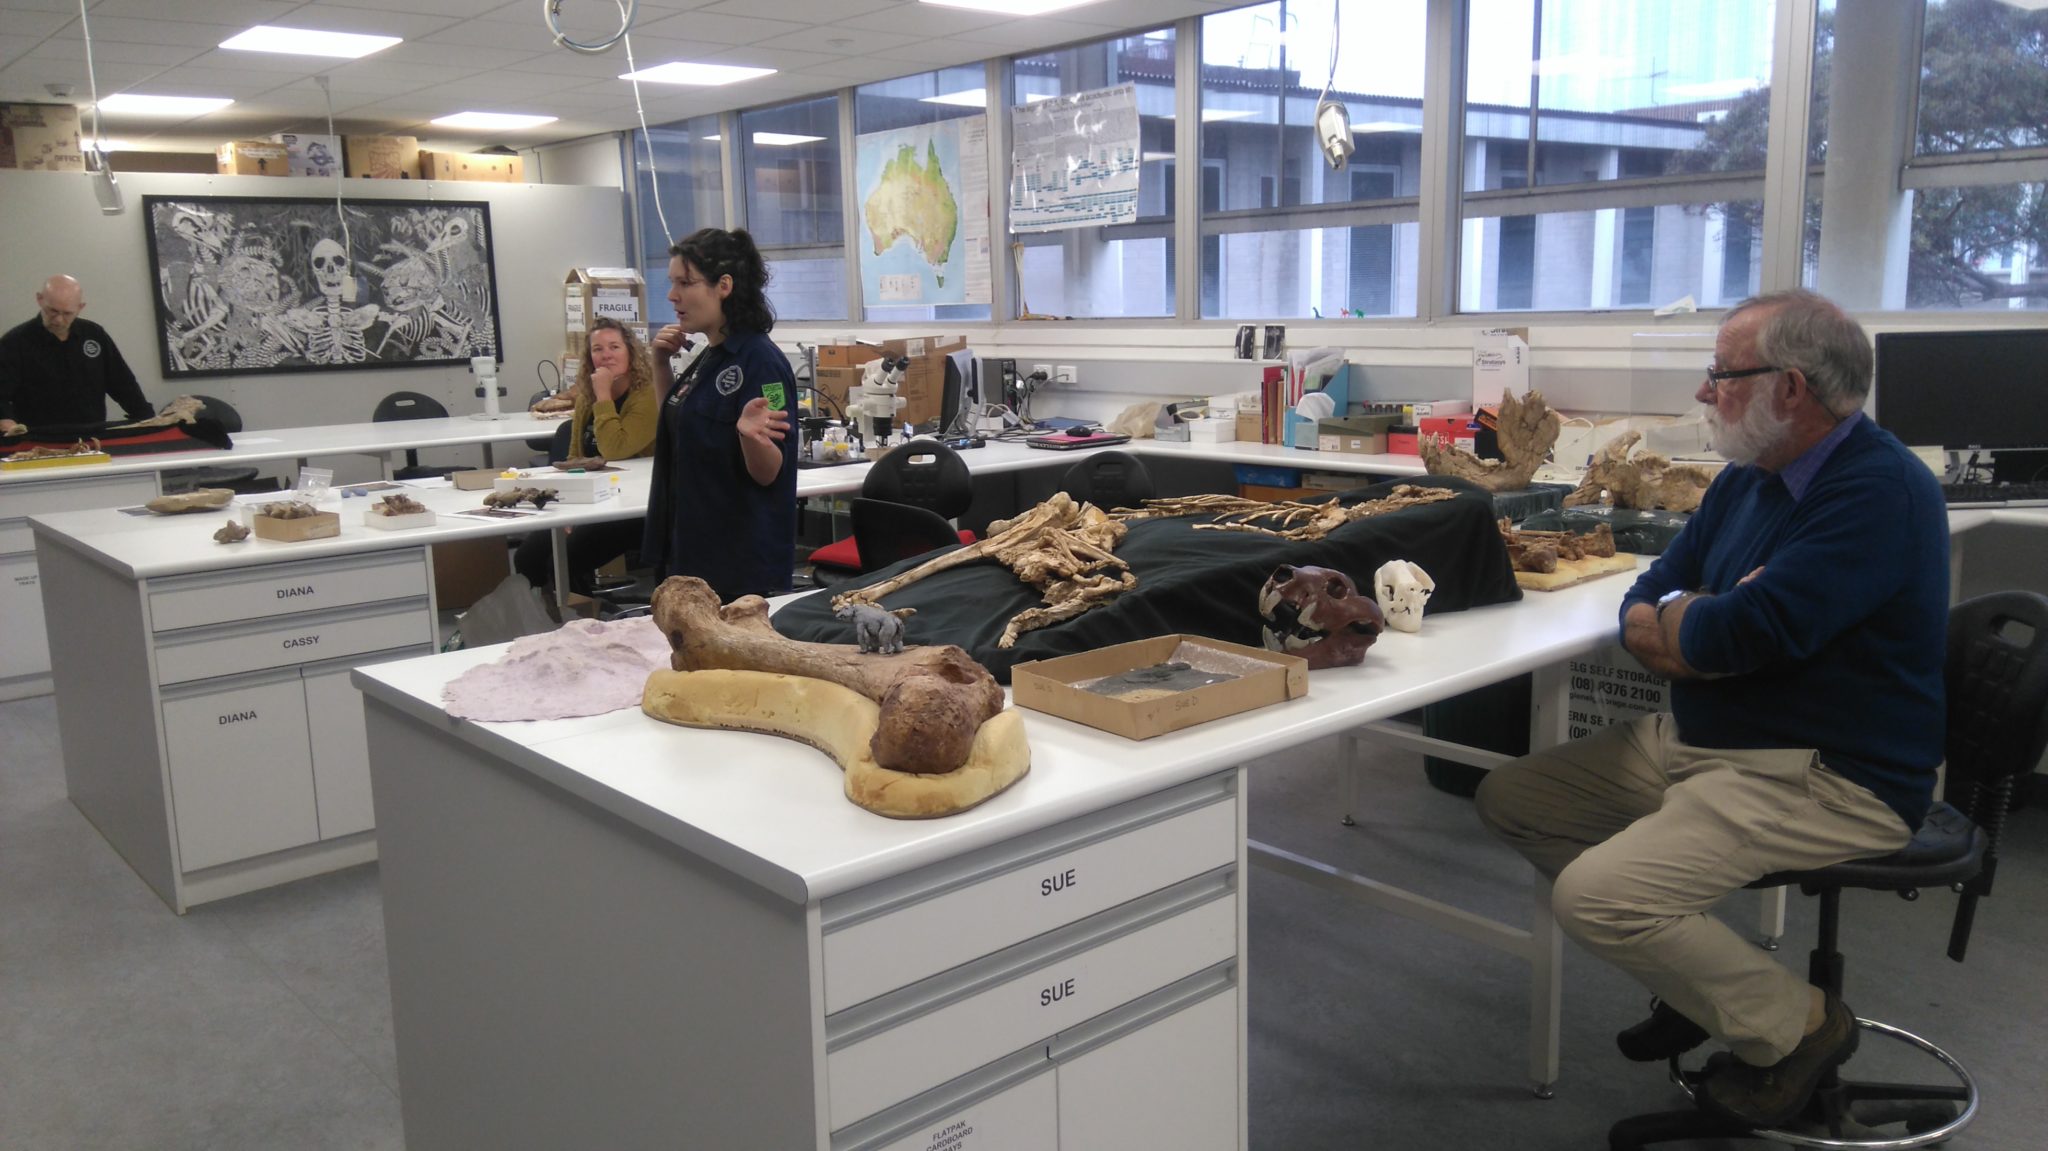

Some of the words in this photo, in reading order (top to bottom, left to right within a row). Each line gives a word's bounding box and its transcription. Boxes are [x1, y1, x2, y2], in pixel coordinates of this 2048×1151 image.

[599, 303, 633, 312] FRAGILE
[276, 585, 315, 599] DIANA
[283, 635, 320, 649] CASSY
[1589, 664, 1615, 678] SELF
[1616, 668, 1668, 688] STORAGE
[1571, 676, 1595, 693] (08)
[1630, 686, 1661, 704] 2100
[218, 710, 257, 726] DIANA
[1041, 868, 1076, 897] SUE
[1040, 978, 1075, 1007] SUE
[926, 1126, 974, 1151] CARDBOARD
[932, 1119, 966, 1142] FLATPAK
